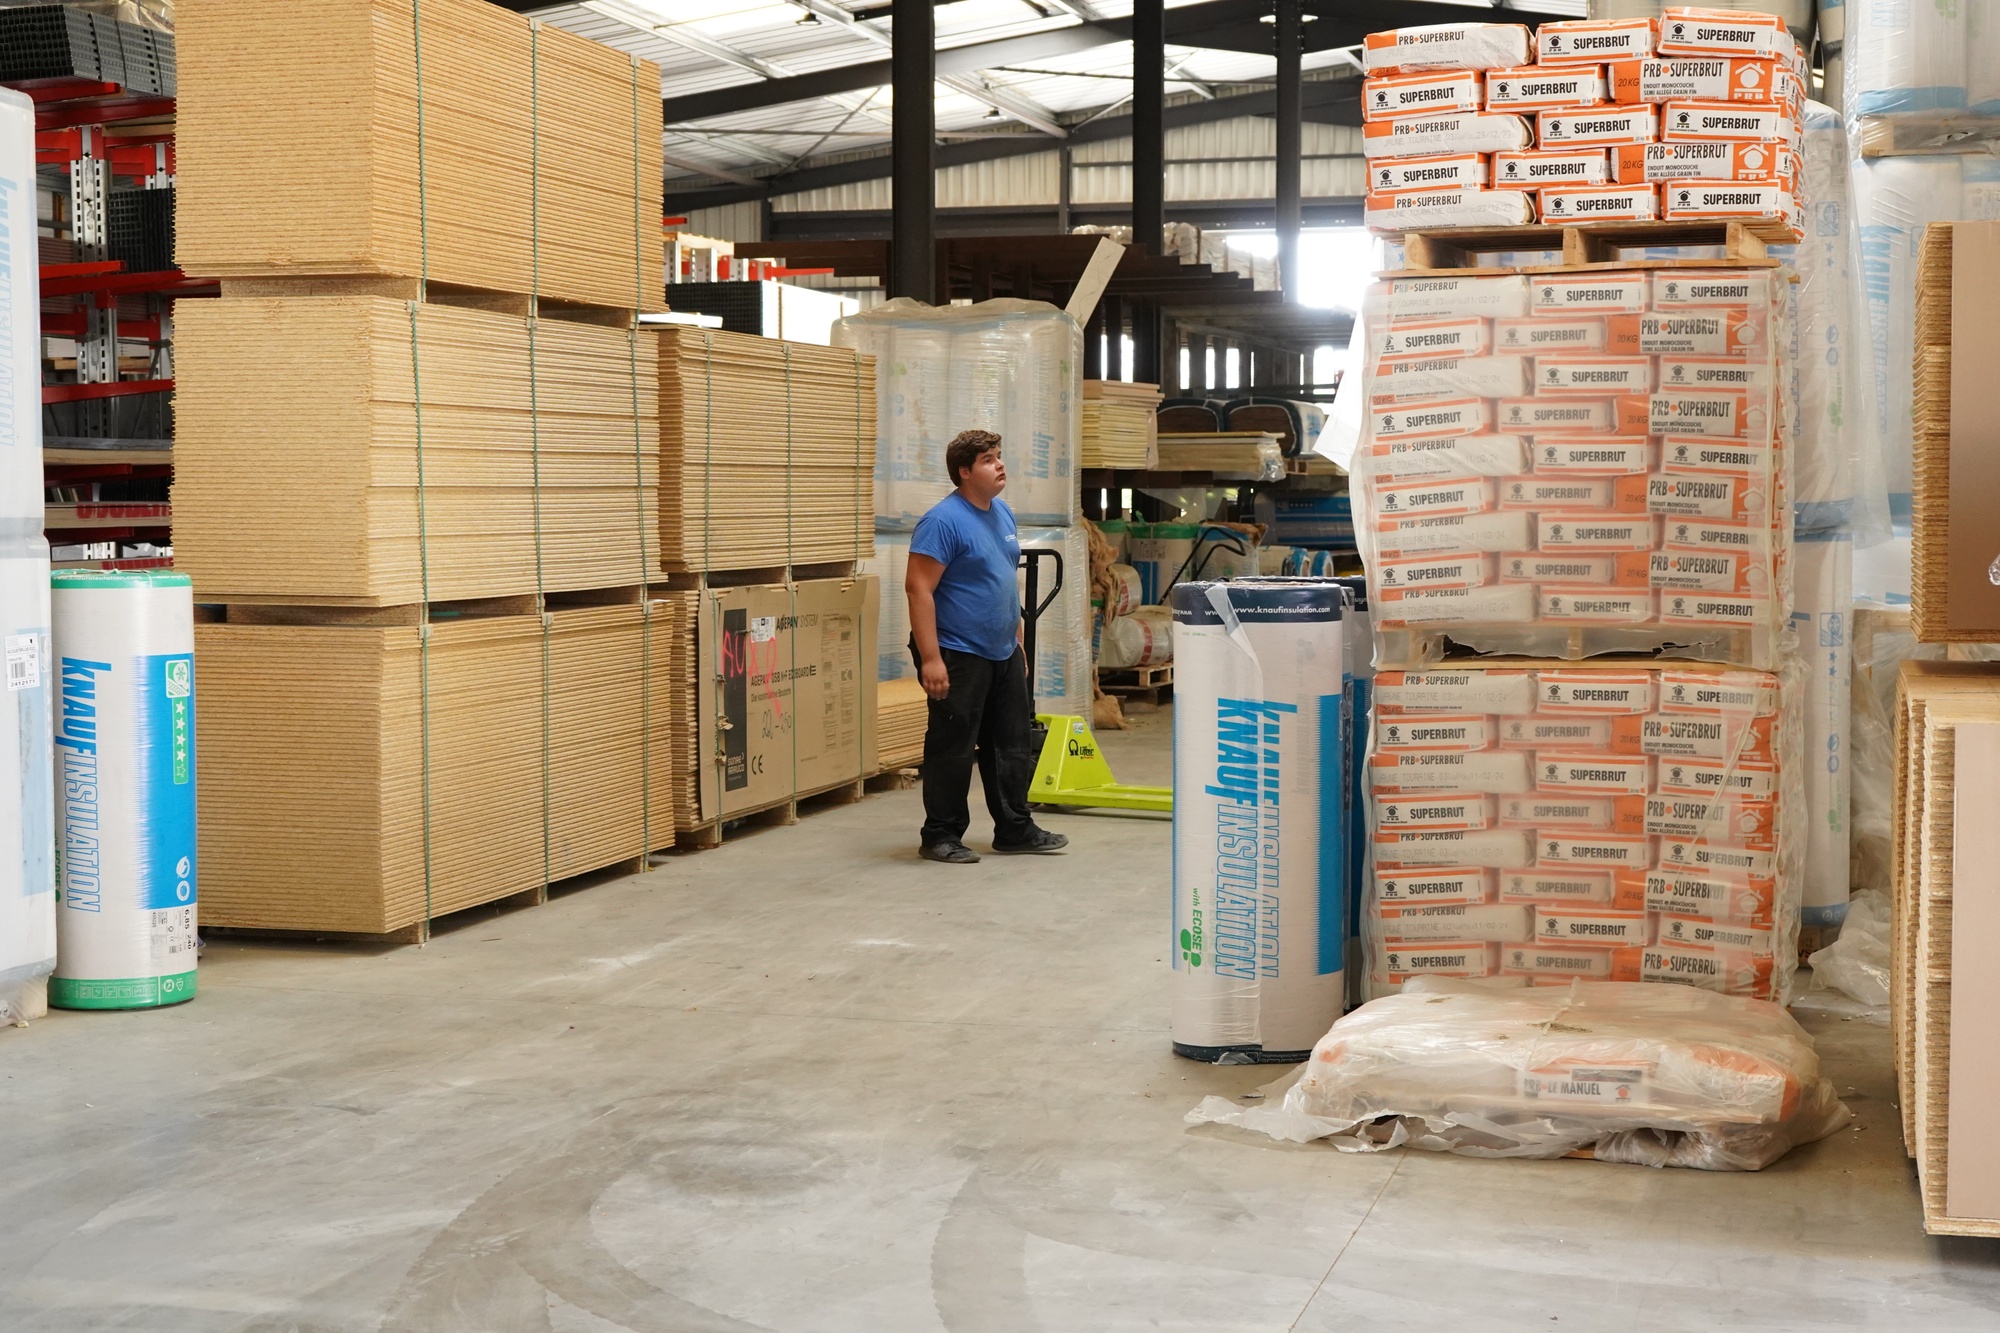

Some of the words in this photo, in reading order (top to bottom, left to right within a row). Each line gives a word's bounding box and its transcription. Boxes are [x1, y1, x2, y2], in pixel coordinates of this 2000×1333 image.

[1420, 31, 1464, 43] SUPERBRUT
[1697, 29, 1755, 42] SUPERBRUT
[1574, 35, 1630, 49] SUPERBRUT
[1644, 64, 1661, 77] PRB
[1670, 62, 1723, 77] SUPERBRUT
[1522, 82, 1577, 95] SUPERBRUT
[1400, 88, 1454, 103] SUPERBRUT
[1415, 121, 1459, 133] SUPERBRUT
[1575, 120, 1630, 133] SUPERBRUT
[1702, 117, 1760, 129] SUPERBRUT
[1648, 146, 1665, 159] PRB
[1674, 144, 1727, 159] SUPERBRUT
[1404, 167, 1458, 182] SUPERBRUT
[1530, 163, 1586, 176] SUPERBRUT
[1417, 195, 1462, 207] SUPERBRUT
[1577, 198, 1633, 211] SUPERBRUT
[1703, 194, 1761, 205] SUPERBRUT
[1415, 282, 1458, 292] SUPERBRUT
[1691, 286, 1748, 297] SUPERBRUT
[1567, 290, 1623, 301] SUPERBRUT
[1642, 320, 1658, 334] PRB
[1668, 319, 1718, 334] SUPERBRUT
[1406, 333, 1460, 347] SUPERBRUT
[1531, 329, 1587, 341] SUPERBRUT
[1414, 360, 1458, 371] SUPERBRUT
[1572, 371, 1628, 382] SUPERBRUT
[1696, 370, 1755, 382] SUPERBRUT
[1535, 409, 1591, 420] SUPERBRUT
[1678, 401, 1730, 417] SUPERBRUT
[1407, 412, 1461, 427] SUPERBRUT
[1412, 440, 1455, 451] SUPERBRUT
[1570, 451, 1626, 462] SUPERBRUT
[1700, 451, 1759, 465] SUPERBRUT
[1536, 488, 1592, 498] SUPERBRUT
[1650, 481, 1667, 496] PRB
[1676, 482, 1728, 499] SUPERBRUT
[1409, 491, 1464, 506] SUPERBRUT
[1576, 529, 1632, 539] SUPERBRUT
[1536, 565, 1591, 575] SUPERBRUT
[1651, 556, 1668, 571] PRB
[1677, 557, 1729, 574] SUPERBRUT
[1407, 566, 1462, 581] SUPERBRUT
[1232, 606, 1330, 614] www.knaufinsulation.com
[1574, 601, 1631, 613] SUPERBRUT
[1697, 603, 1752, 616] SUPERBRUT
[1426, 676, 1469, 685] SUPERBRUT
[1573, 690, 1629, 701] SUPERBRUT
[1697, 690, 1754, 704] SUPERBRUT
[1412, 728, 1465, 740] SUPERBRUT
[1536, 727, 1590, 737] SUPERBRUT
[1644, 721, 1661, 736] PRB
[1670, 723, 1721, 739] SUPERBRUT
[1421, 755, 1464, 764] SUPERBRUT
[1571, 770, 1626, 781] SUPERBRUT
[1410, 807, 1464, 819] SUPERBRUT
[1535, 807, 1589, 816] SUPERBRUT
[1648, 801, 1664, 817] PRB
[63, 751, 100, 913] INSULATION
[1572, 847, 1628, 859] SUPERBRUT
[1696, 851, 1753, 867] SUPERBRUT
[1409, 882, 1463, 894] SUPERBRUT
[1536, 882, 1591, 893] SUPERBRUT
[1192, 909, 1202, 950] ECOSE
[1570, 924, 1626, 935] SUPERBRUT
[1695, 929, 1752, 944] SUPERBRUT
[1411, 956, 1465, 967] SUPERBRUT
[1536, 957, 1592, 969] SUPERBRUT
[1645, 953, 1662, 969] PRB
[1561, 1083, 1601, 1095] MANUEL
